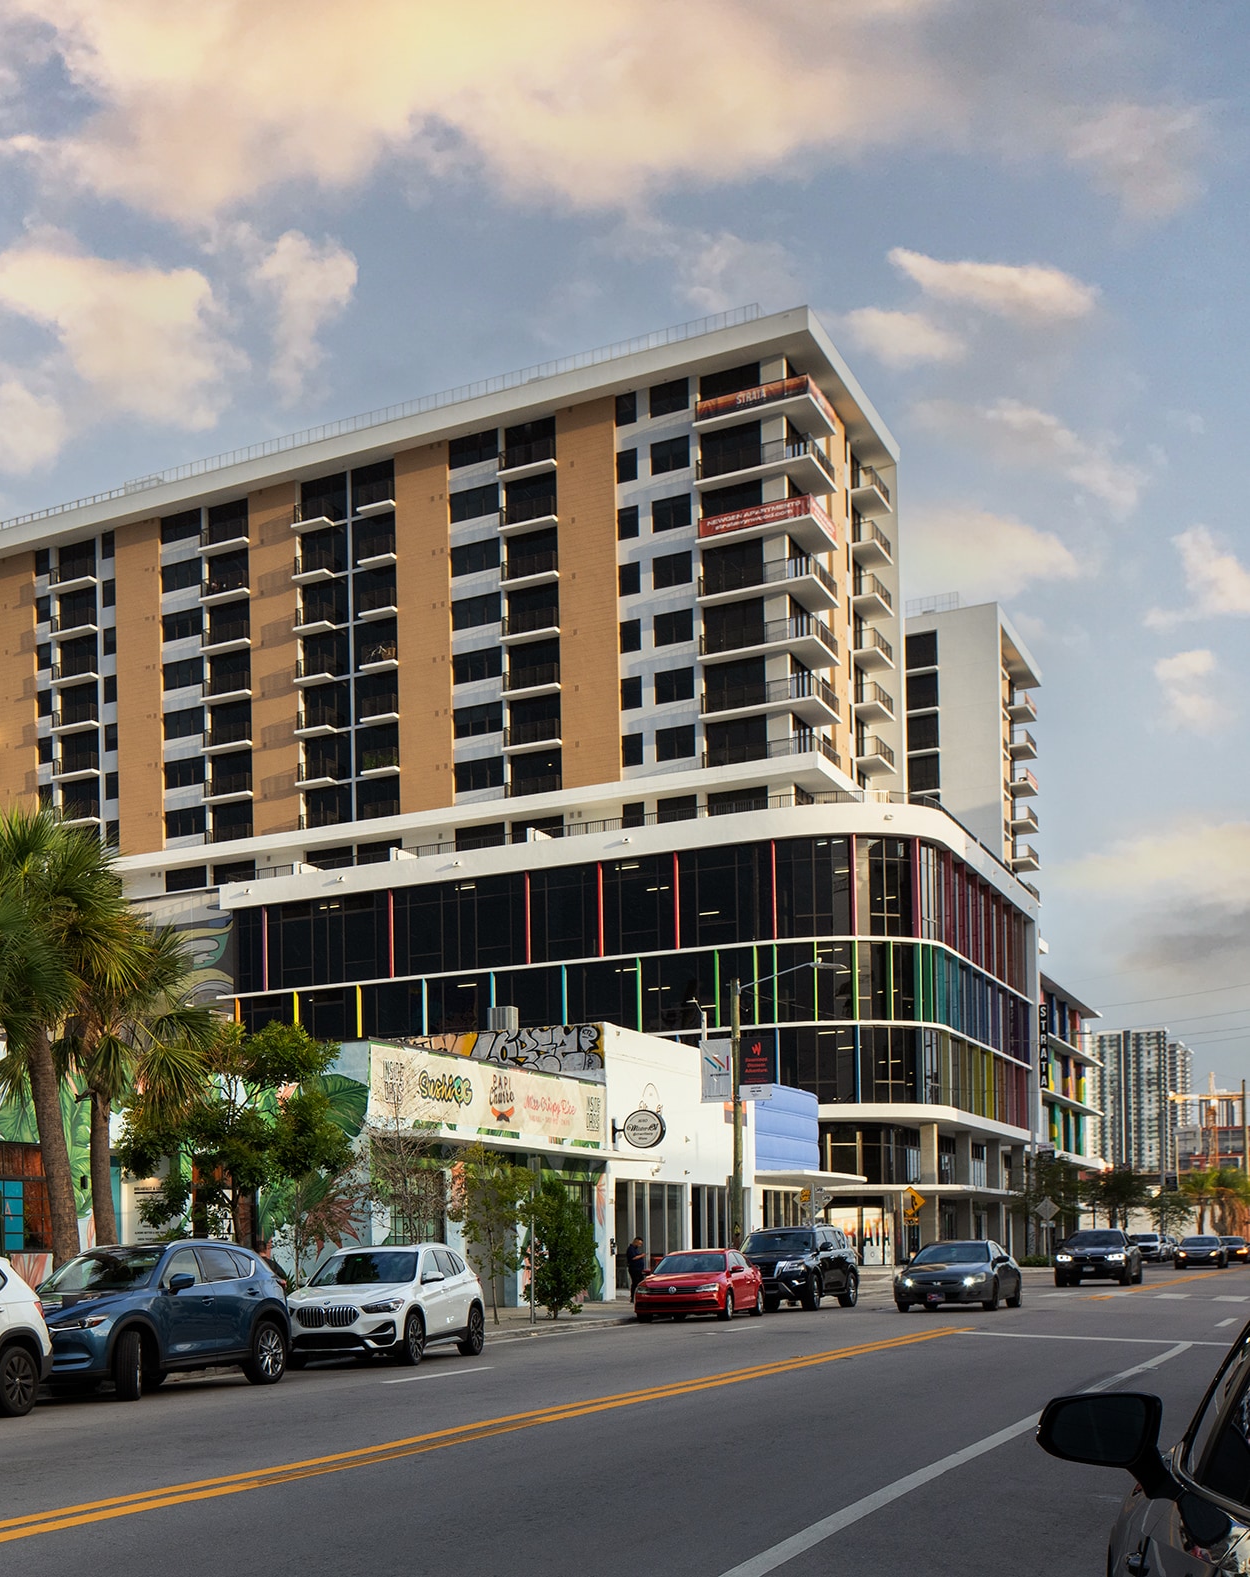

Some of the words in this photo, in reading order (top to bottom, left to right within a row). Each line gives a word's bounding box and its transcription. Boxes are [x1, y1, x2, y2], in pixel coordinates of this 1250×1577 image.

[736, 388, 767, 405] STRATA
[706, 513, 743, 527] NEWGEN
[743, 500, 801, 518] APARTMENTS
[1039, 1006, 1048, 1087] STRATA
[493, 1074, 512, 1091] PAPI
[489, 1086, 515, 1105] Churro
